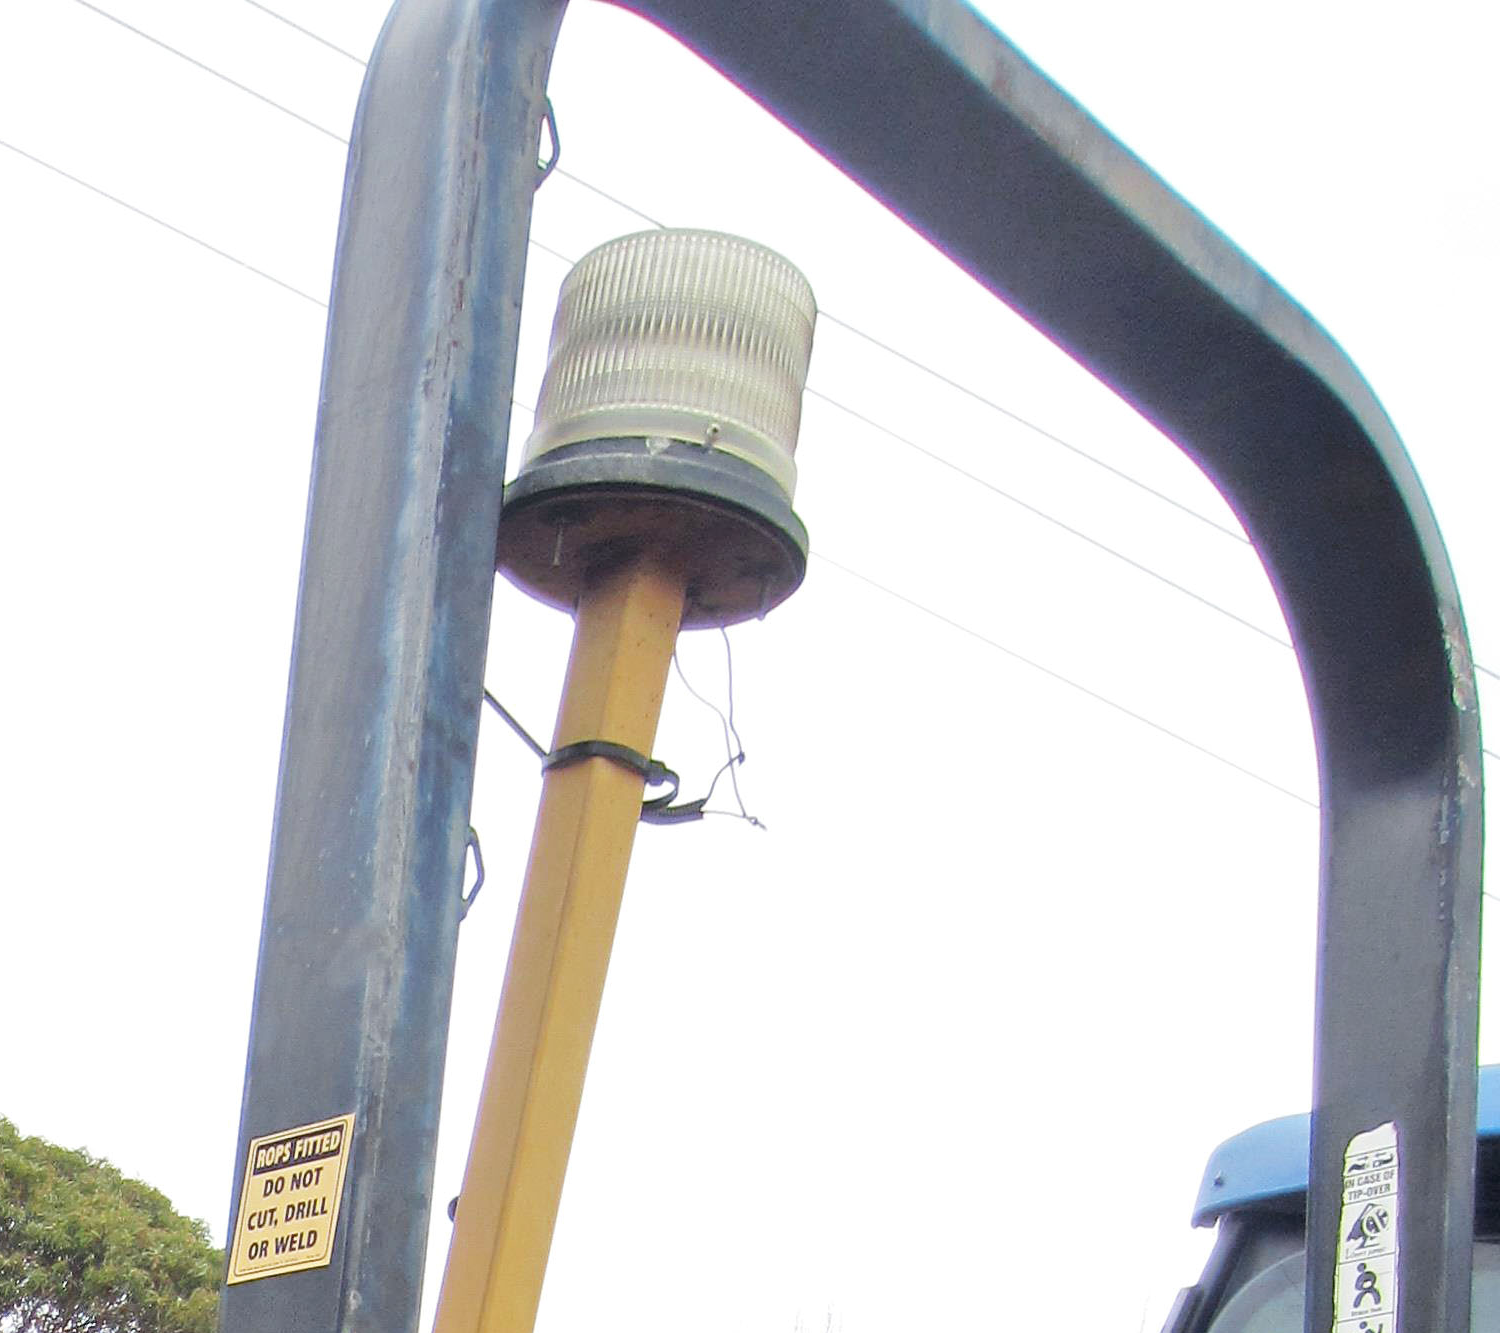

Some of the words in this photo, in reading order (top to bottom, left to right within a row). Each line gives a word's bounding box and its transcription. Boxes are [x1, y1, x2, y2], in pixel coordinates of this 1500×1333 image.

[256, 1142, 291, 1170] ROPS
[294, 1130, 341, 1162] FITTED
[263, 1176, 285, 1198] DO
[290, 1167, 324, 1191] NOT
[1348, 1183, 1391, 1200] TIP-OVER
[1358, 1172, 1380, 1186] CASE
[1383, 1169, 1395, 1180] OF
[247, 1207, 279, 1231] CUT,
[285, 1196, 328, 1223] DRILL
[248, 1240, 269, 1260] OR
[274, 1229, 318, 1255] WELD
